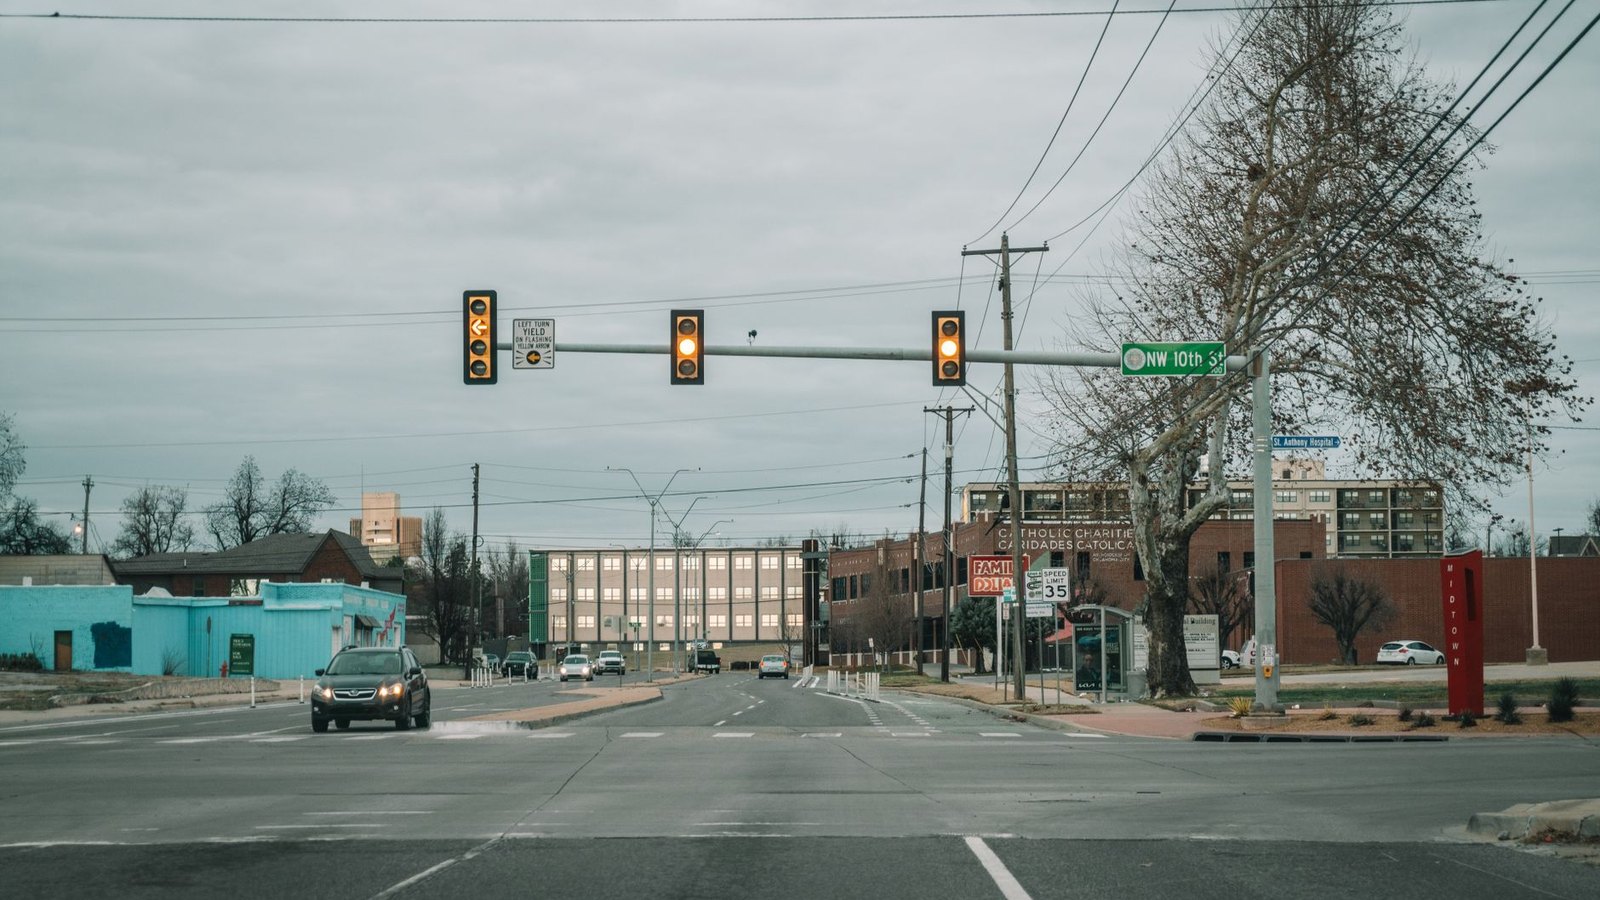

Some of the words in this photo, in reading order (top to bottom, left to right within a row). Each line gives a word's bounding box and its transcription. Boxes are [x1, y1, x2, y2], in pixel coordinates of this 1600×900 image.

[1146, 351, 1167, 367] NW
[1173, 351, 1202, 367] 10th
[1208, 350, 1224, 367] St
[1284, 438, 1307, 448] Anthony
[1310, 438, 1334, 447] Hospital
[1075, 529, 1134, 538] CHARITIE
[974, 560, 1013, 575] FAMIL
[974, 577, 1013, 592] DOLLA
[1045, 585, 1067, 597] 35
[1191, 617, 1216, 625] Building
[1447, 564, 1460, 666] MIDTOWN
